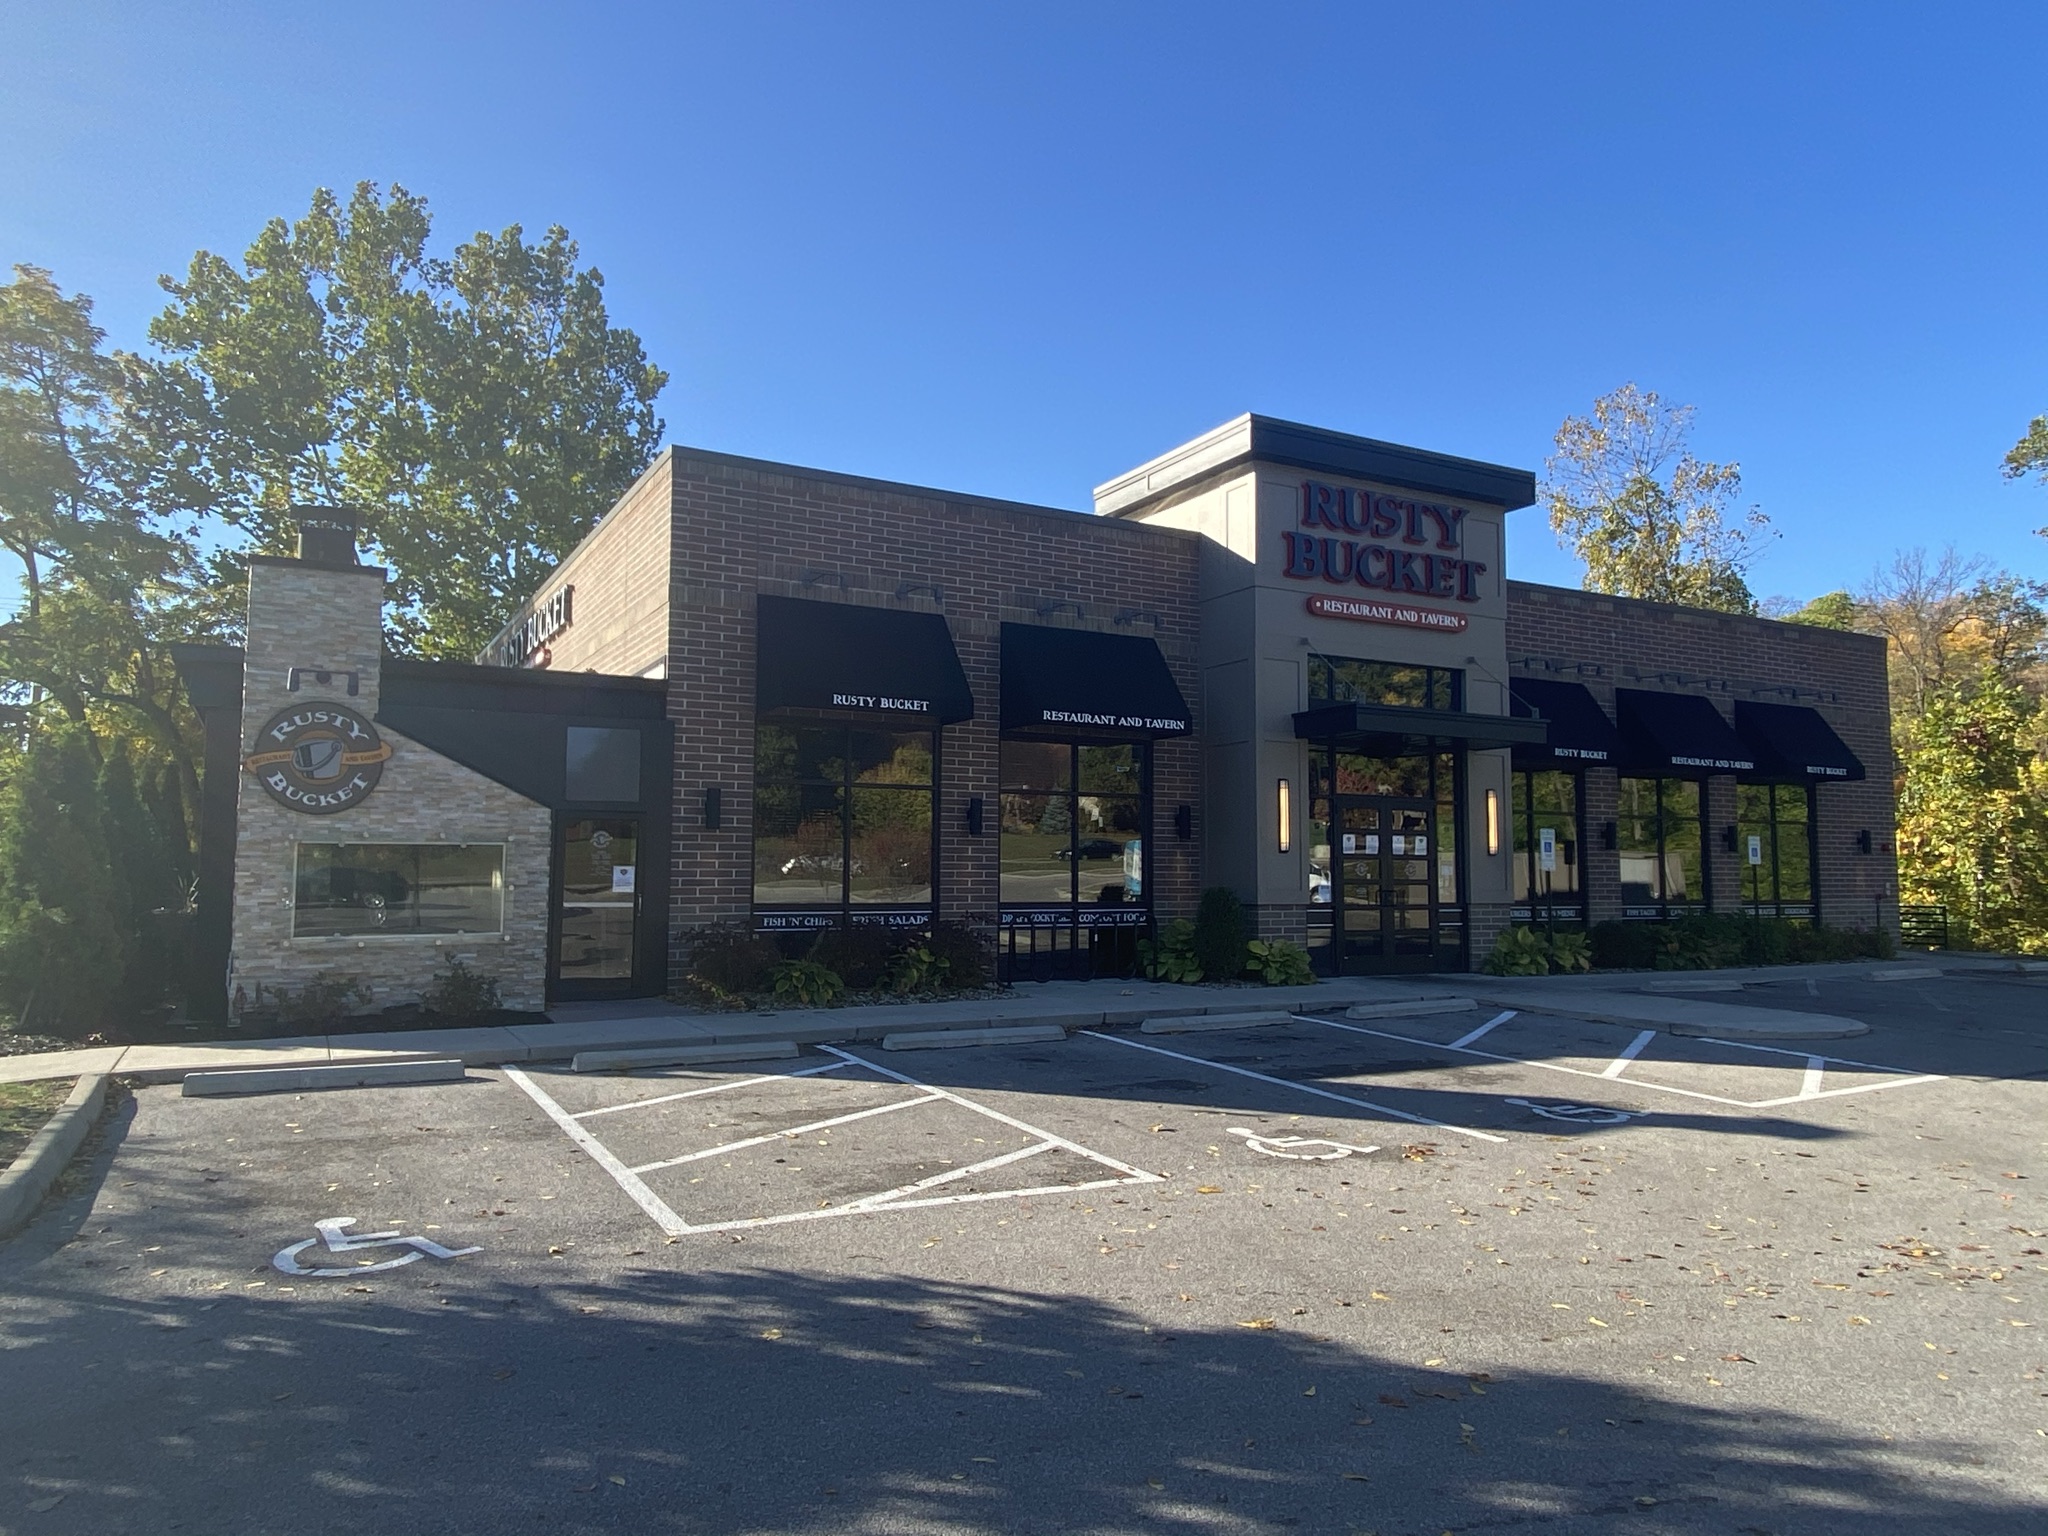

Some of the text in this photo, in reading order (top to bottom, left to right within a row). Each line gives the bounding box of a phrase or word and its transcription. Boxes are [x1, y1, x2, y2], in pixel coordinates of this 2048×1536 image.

[1300, 480, 1470, 551] RUSTY
[1281, 531, 1488, 603] BUCKET
[527, 584, 572, 656] BUCKET
[1323, 599, 1459, 627] RESTAURANT AND TAVERN
[832, 693, 930, 712] RUSTY BUCKET
[270, 711, 370, 743] RUSTY
[1042, 709, 1186, 730] RESTAURANT AND TAVERN
[1554, 747, 1608, 760] RUSTY BUCKET
[1671, 756, 1714, 767] RESTAURANT
[266, 770, 369, 807] BUCKET
[763, 917, 786, 928] FISH
[888, 915, 929, 926] SALADS
